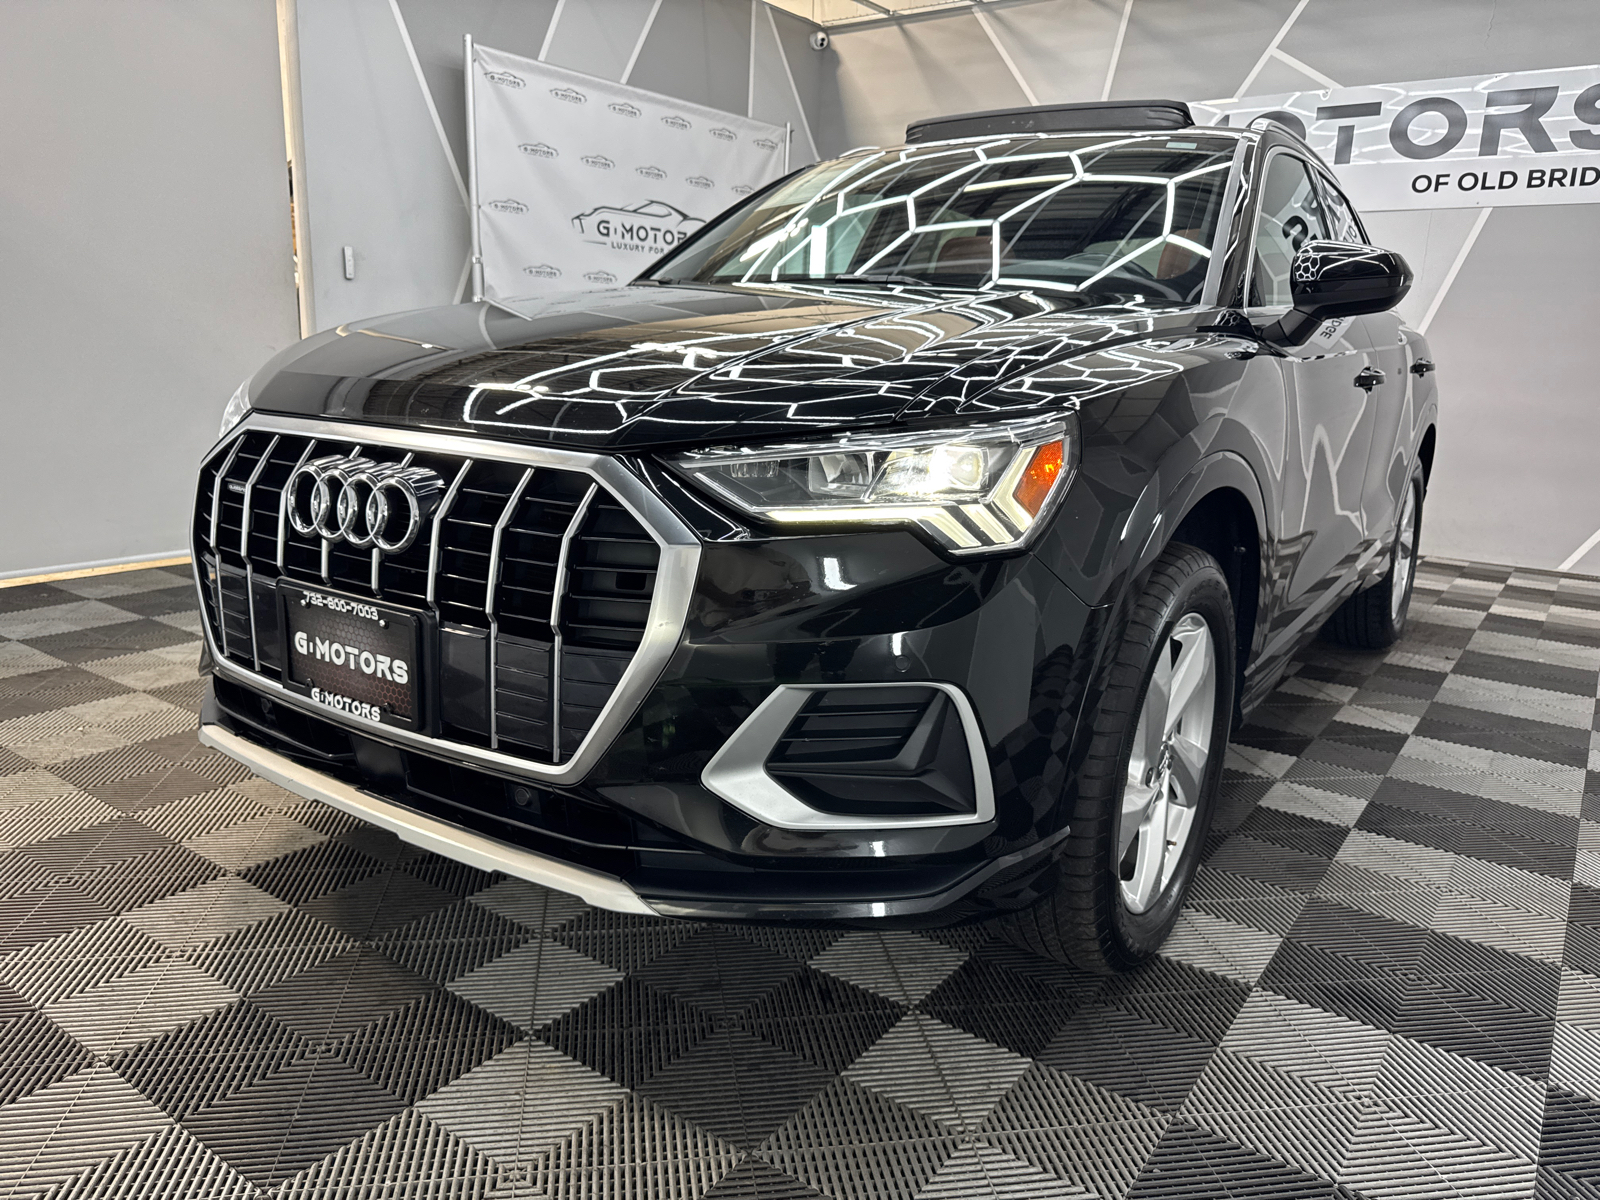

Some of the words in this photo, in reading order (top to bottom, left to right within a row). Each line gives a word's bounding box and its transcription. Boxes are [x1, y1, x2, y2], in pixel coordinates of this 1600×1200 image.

[1411, 174, 1451, 193] OF
[1457, 170, 1519, 192] OLD
[1526, 166, 1600, 189] BRID
[611, 242, 646, 253] LUXURY
[302, 590, 379, 621] 732-800-7003
